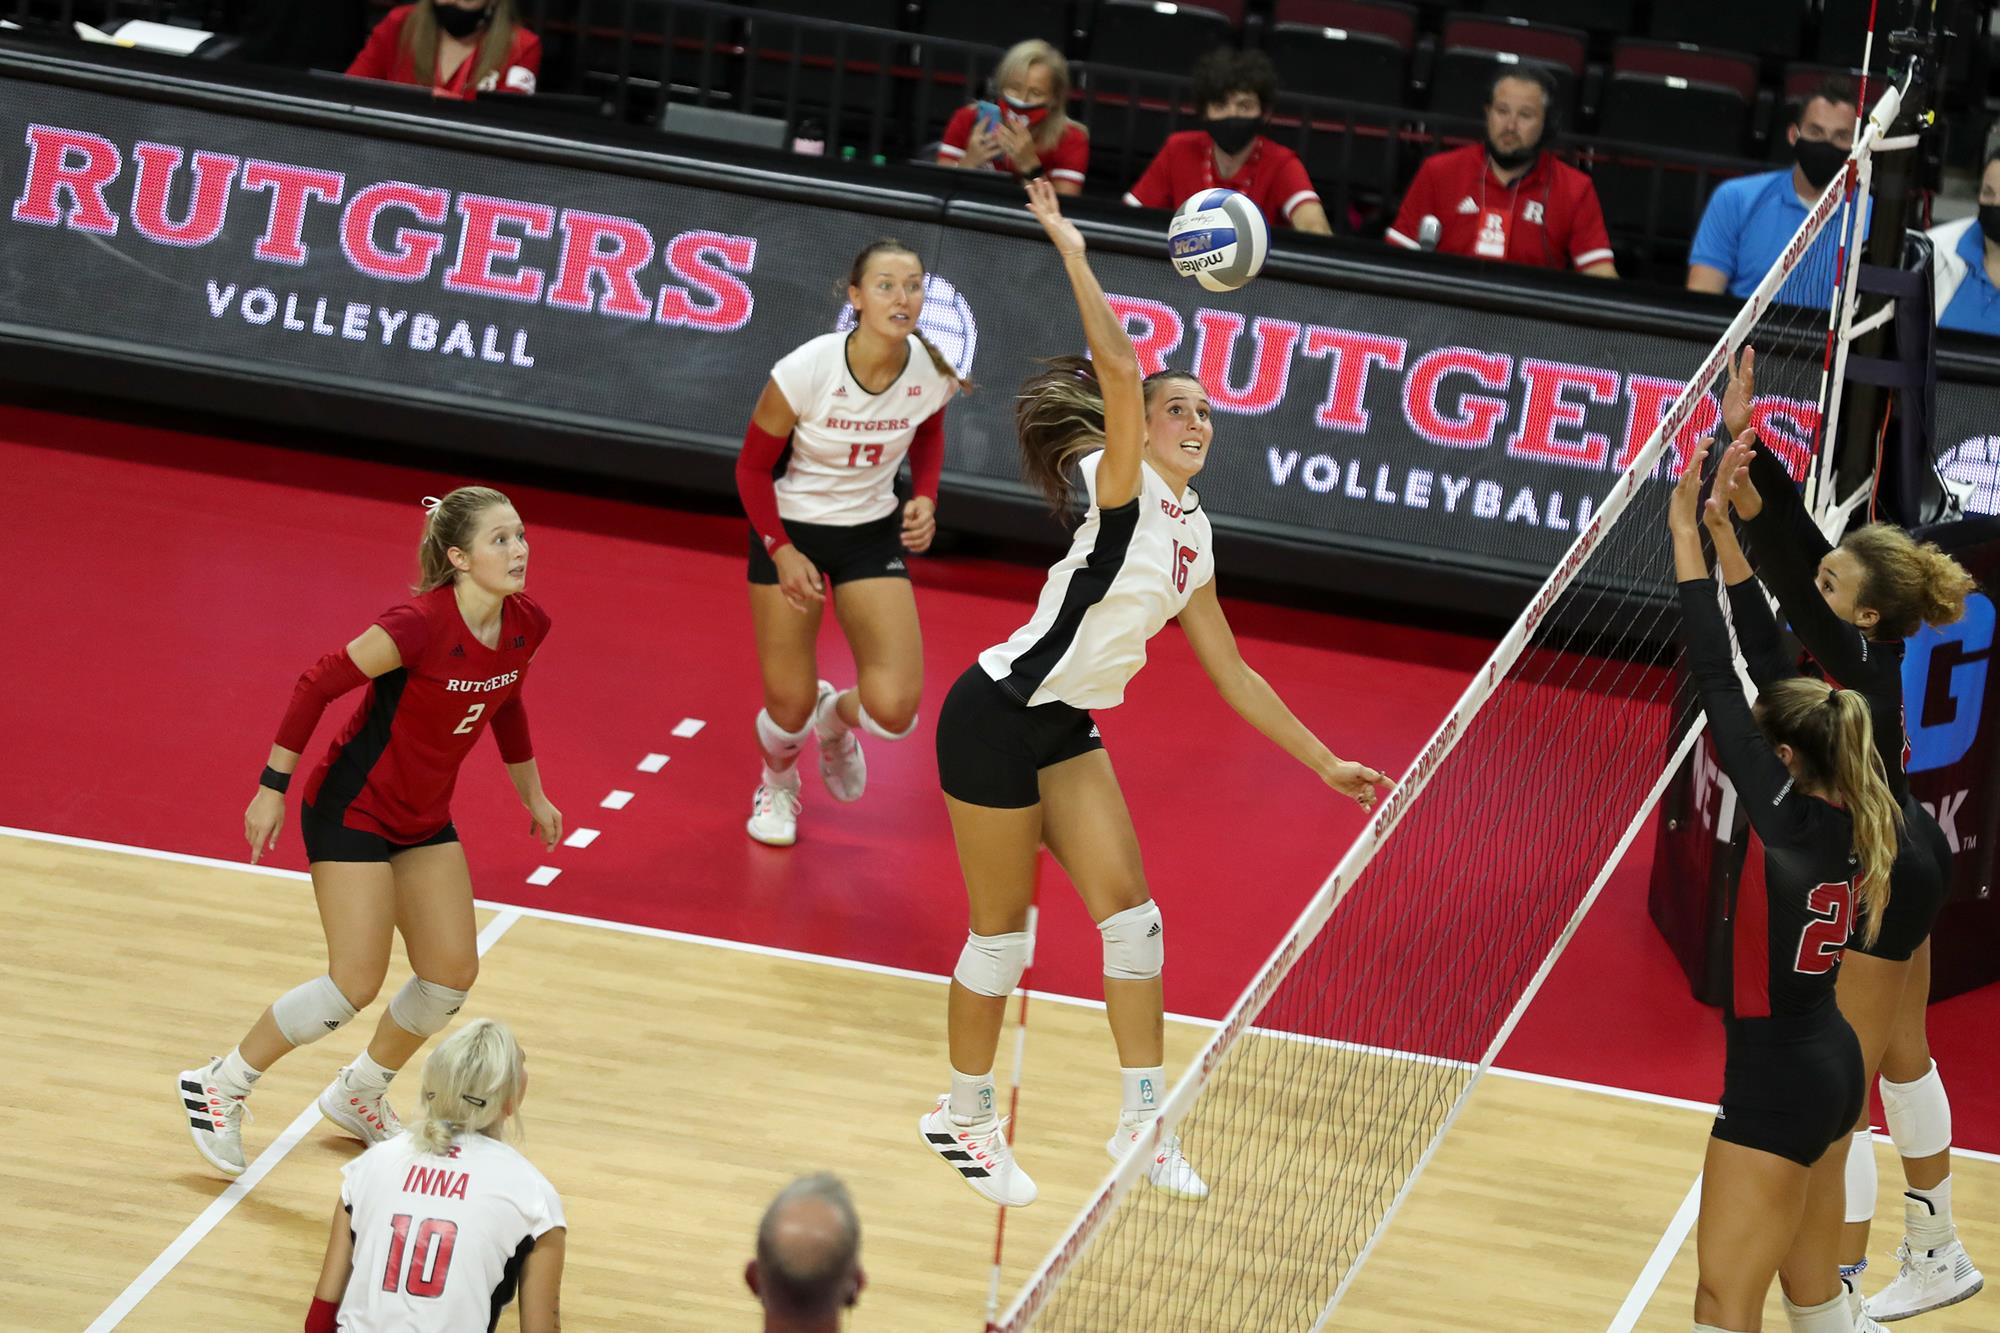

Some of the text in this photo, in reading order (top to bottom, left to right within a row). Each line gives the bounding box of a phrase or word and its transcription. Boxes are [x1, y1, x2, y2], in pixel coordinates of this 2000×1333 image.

[13, 123, 757, 332] RUTGERS
[1177, 251, 1223, 272] molten
[207, 280, 535, 368] VOLLEYBALL
[826, 417, 910, 431] RUTGERS
[847, 443, 884, 469] 13
[1172, 538, 1198, 594] 16
[446, 670, 518, 693] RUTGERS
[453, 703, 485, 735] 2
[402, 1164, 471, 1200] INNA
[382, 1213, 459, 1299] 10
